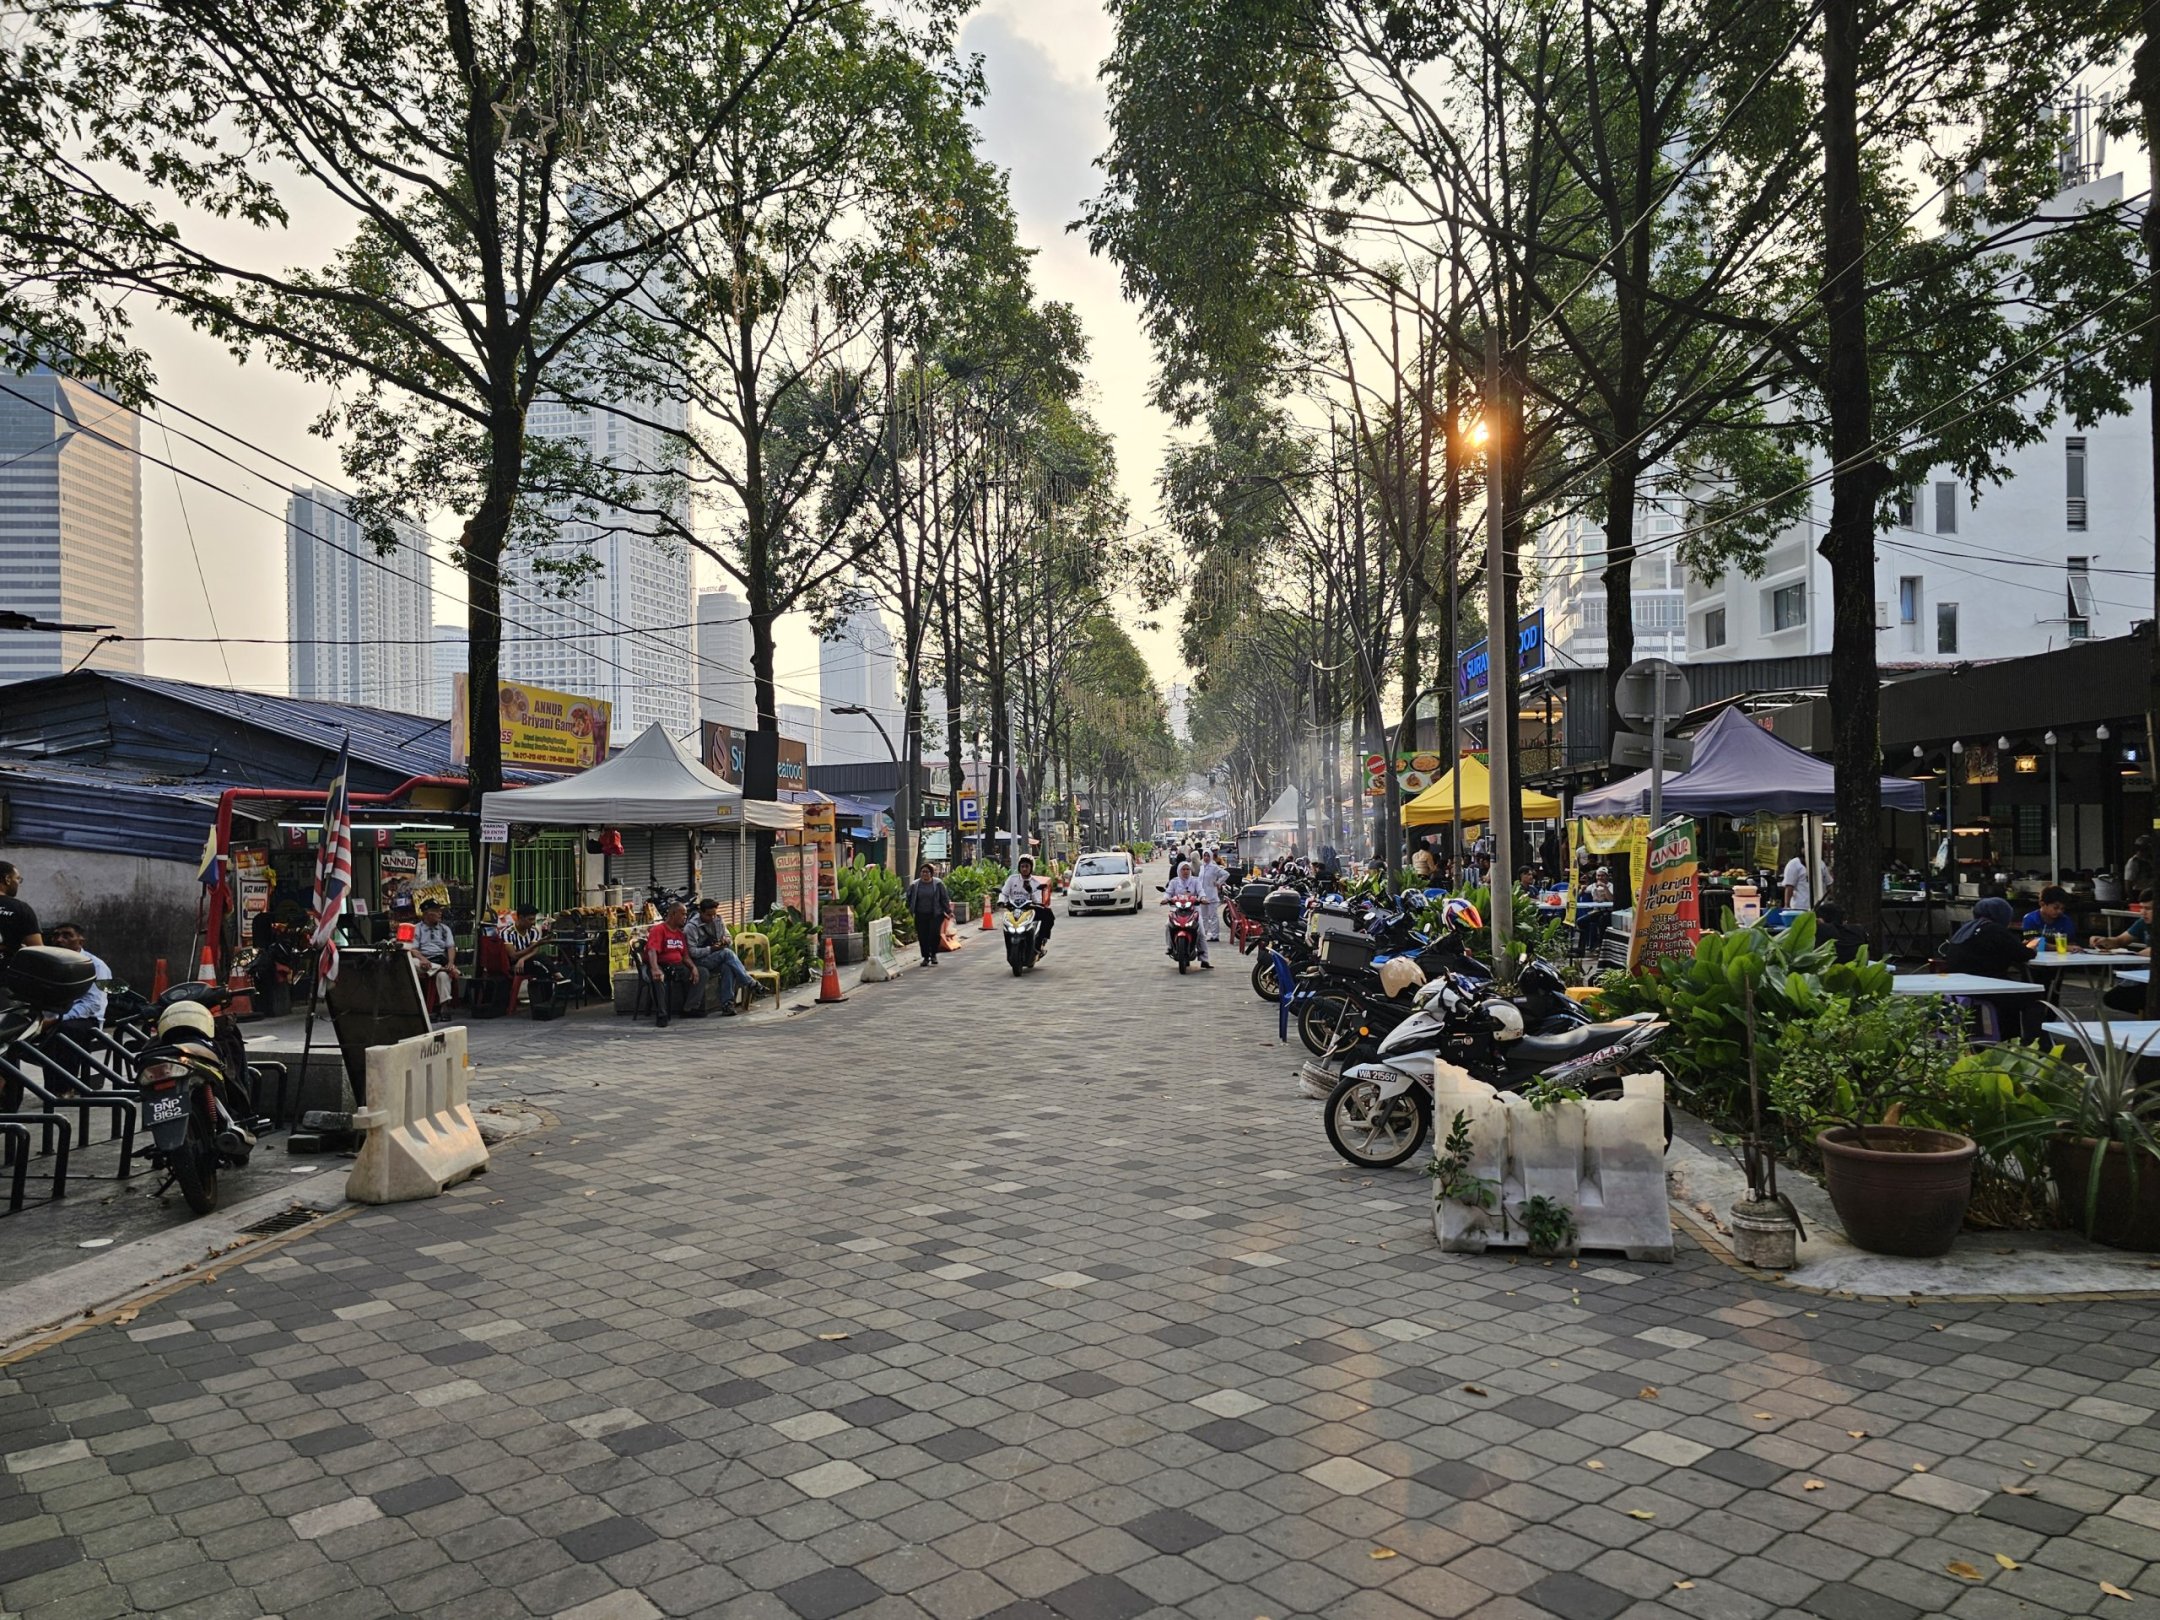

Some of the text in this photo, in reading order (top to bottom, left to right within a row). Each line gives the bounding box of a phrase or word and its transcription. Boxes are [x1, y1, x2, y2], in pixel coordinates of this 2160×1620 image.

[534, 700, 563, 717] ANNUR
[521, 713, 553, 730] Briyani
[777, 758, 803, 780] eafood
[963, 799, 977, 819] P
[382, 856, 416, 868] ANNUR
[253, 885, 268, 894] MART
[1359, 1069, 1371, 1079] WA
[154, 1098, 180, 1113] BNP
[153, 1107, 182, 1121] 8162
